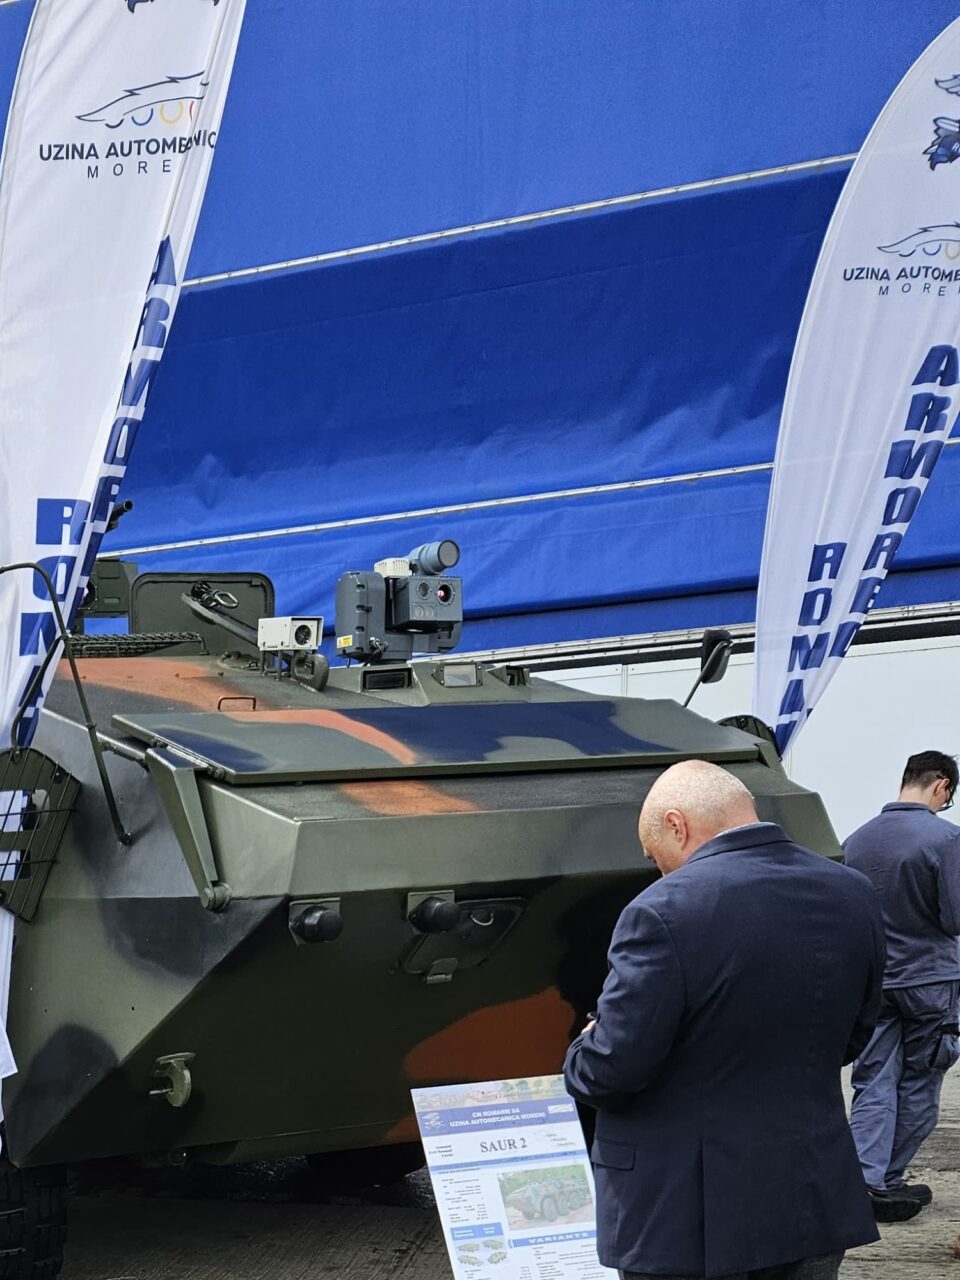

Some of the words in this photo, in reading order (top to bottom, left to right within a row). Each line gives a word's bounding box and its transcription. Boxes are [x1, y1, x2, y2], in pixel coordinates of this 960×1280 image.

[39, 141, 100, 162] UZINA
[87, 158, 172, 179] MORE
[843, 266, 891, 282] UZINA
[895, 265, 960, 283] AUTOME
[878, 282, 960, 297] MORE
[449, 1120, 470, 1128] UZINA
[479, 1138, 518, 1154] SAUR
[520, 1137, 528, 1149] 2
